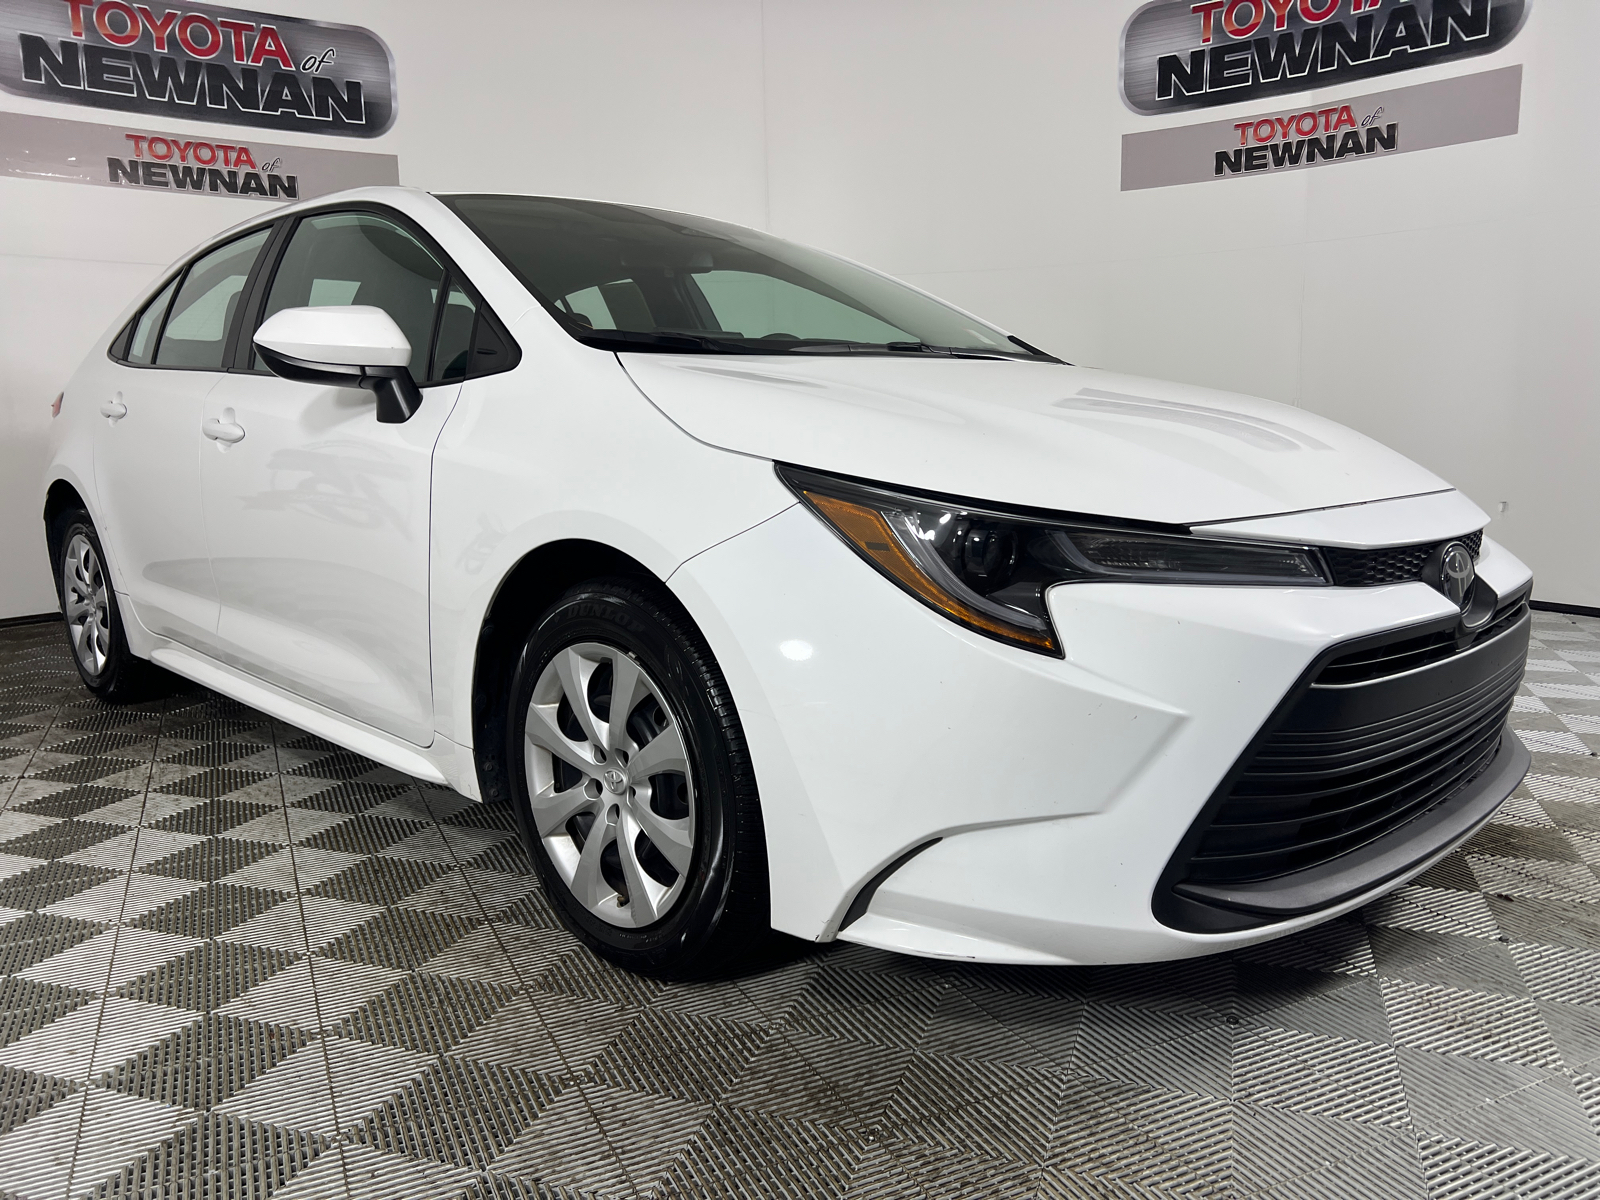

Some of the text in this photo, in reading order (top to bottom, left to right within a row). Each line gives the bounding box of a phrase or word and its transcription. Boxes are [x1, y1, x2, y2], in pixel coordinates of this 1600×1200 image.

[62, 0, 336, 73] TOYOTA of
[1191, 0, 1408, 44] TOYO
[1155, 0, 1492, 101] NEWNAN
[19, 32, 366, 125] NEWNAN
[1233, 104, 1384, 146] TOYOTA of
[125, 133, 281, 172] TOYOTA of
[1213, 121, 1399, 177] NEWNAN
[106, 156, 299, 200] NEWNAN
[566, 603, 646, 633] DUNLOP
